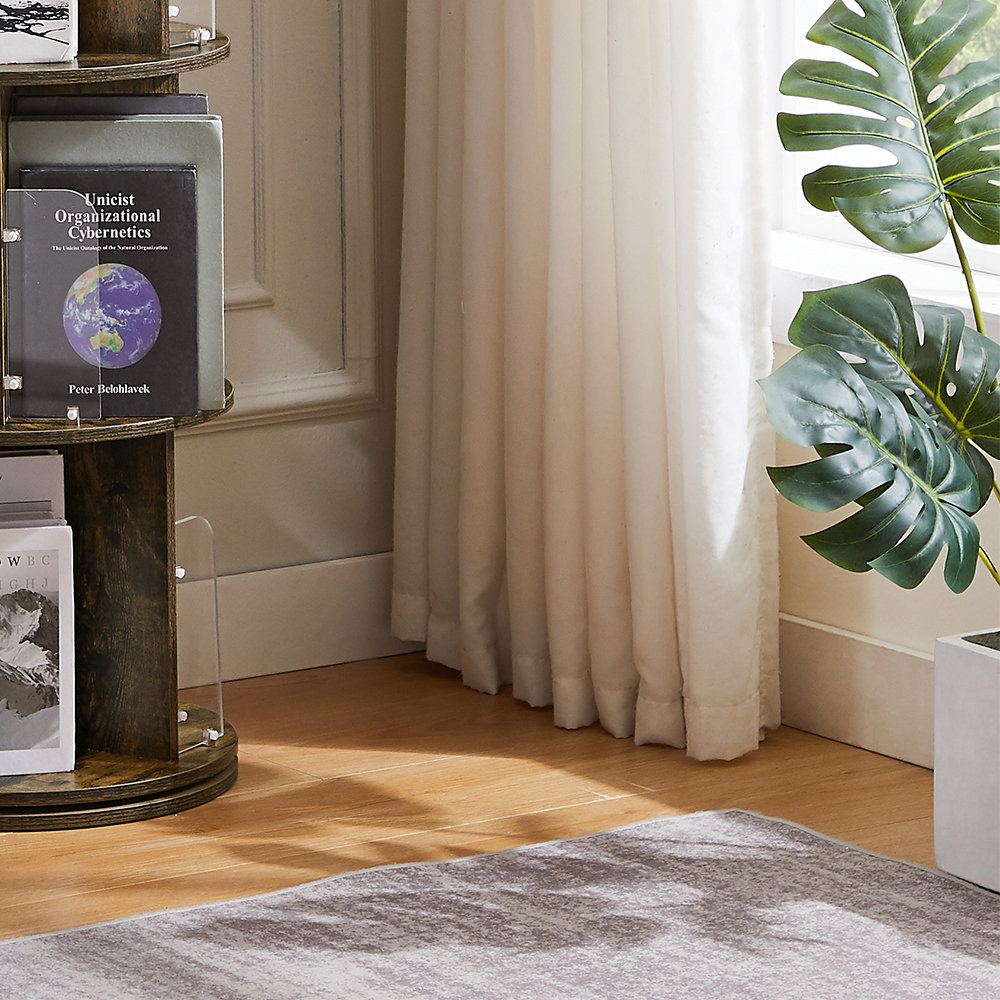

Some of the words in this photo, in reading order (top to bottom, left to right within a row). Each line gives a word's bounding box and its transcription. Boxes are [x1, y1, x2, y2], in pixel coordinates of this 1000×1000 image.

[84, 192, 135, 206] Unicist
[55, 208, 161, 226] Organizational
[68, 225, 152, 242] Cybernetics
[69, 384, 95, 394] Peter
[97, 384, 151, 394] Belohlavek
